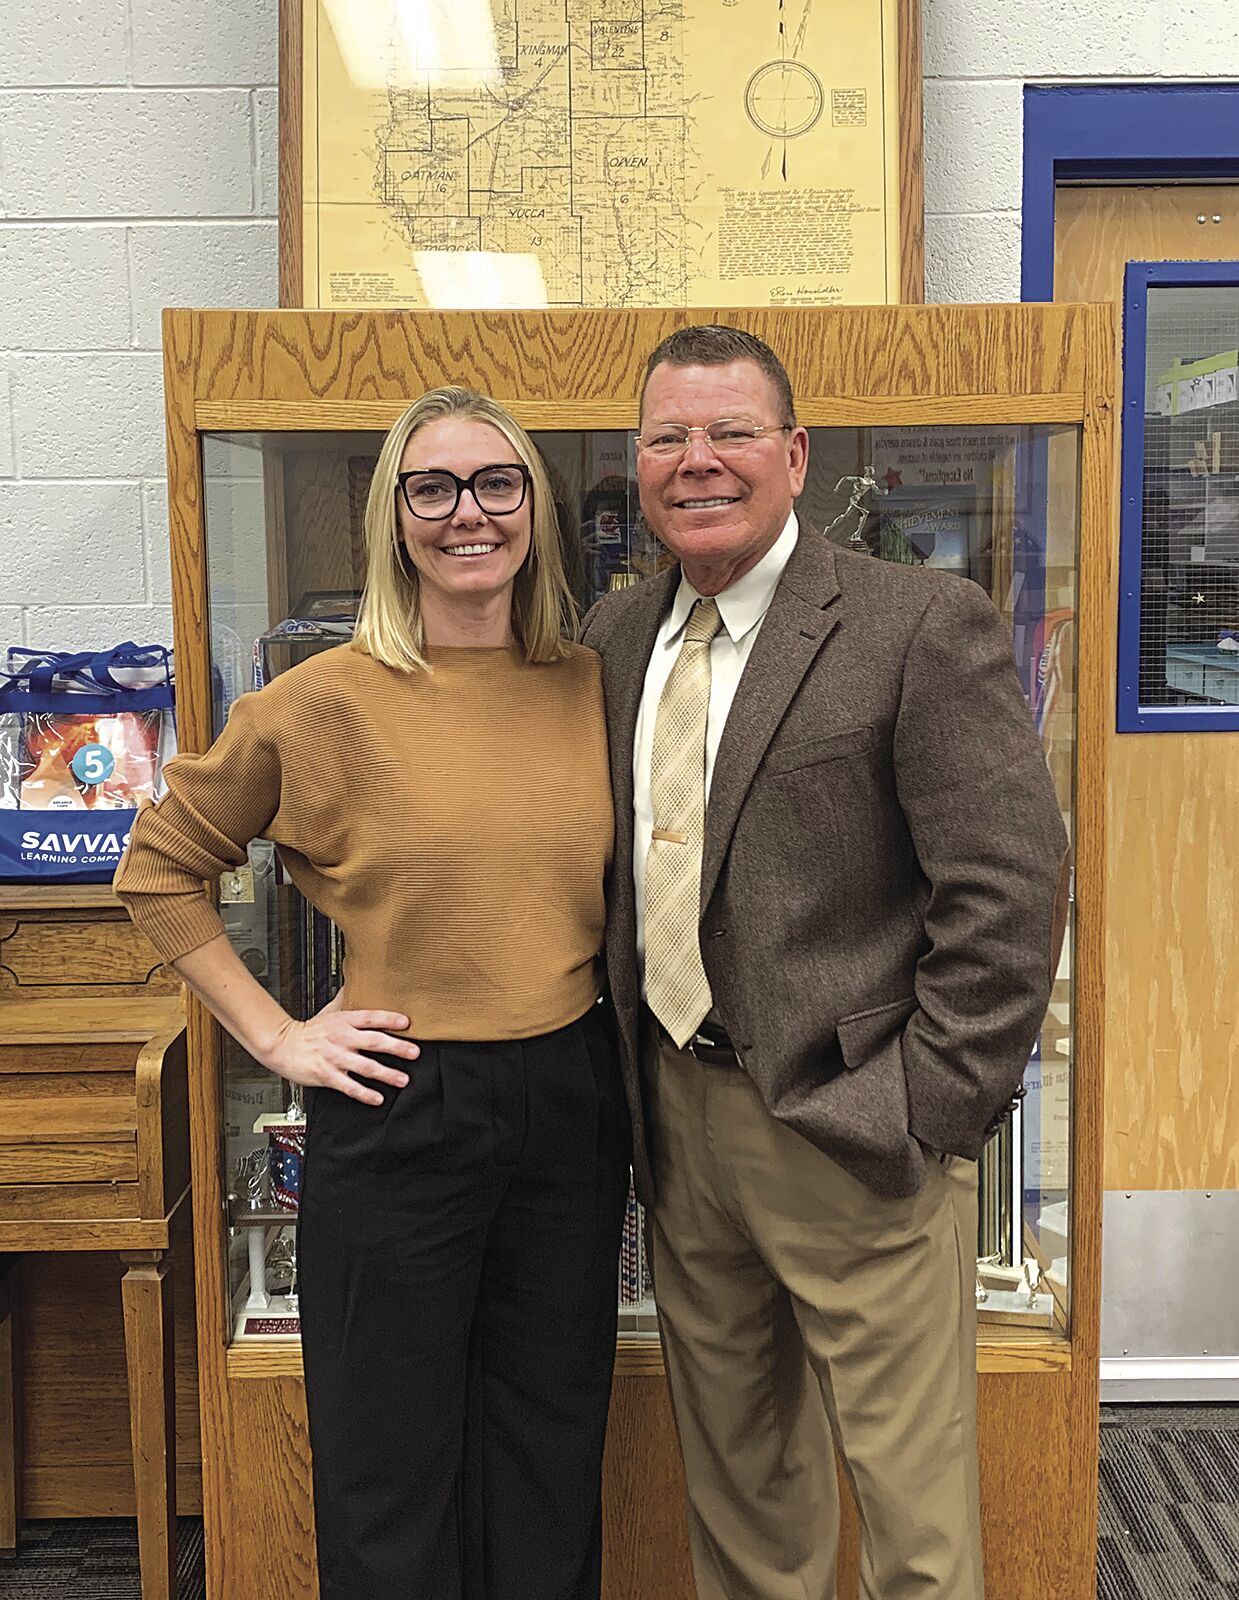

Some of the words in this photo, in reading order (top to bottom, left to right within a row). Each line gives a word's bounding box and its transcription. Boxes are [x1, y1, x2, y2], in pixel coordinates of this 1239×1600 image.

[593, 25, 640, 35] VALENTINE
[660, 31, 669, 42] 8
[520, 45, 568, 55] KINGMAN
[611, 47, 625, 57] 22
[534, 58, 543, 68] 4
[609, 157, 648, 168] OWEN
[401, 170, 453, 181] OATMAN
[435, 183, 447, 193] 16
[620, 194, 629, 205] 6
[508, 208, 545, 219] YUCCA
[530, 236, 543, 247] 13
[884, 506, 960, 531] ACHIEVEMENT
[923, 521, 962, 532] AWARD
[85, 750, 102, 778] 5
[21, 852, 77, 864] LEARNING
[81, 855, 119, 864] COMPA
